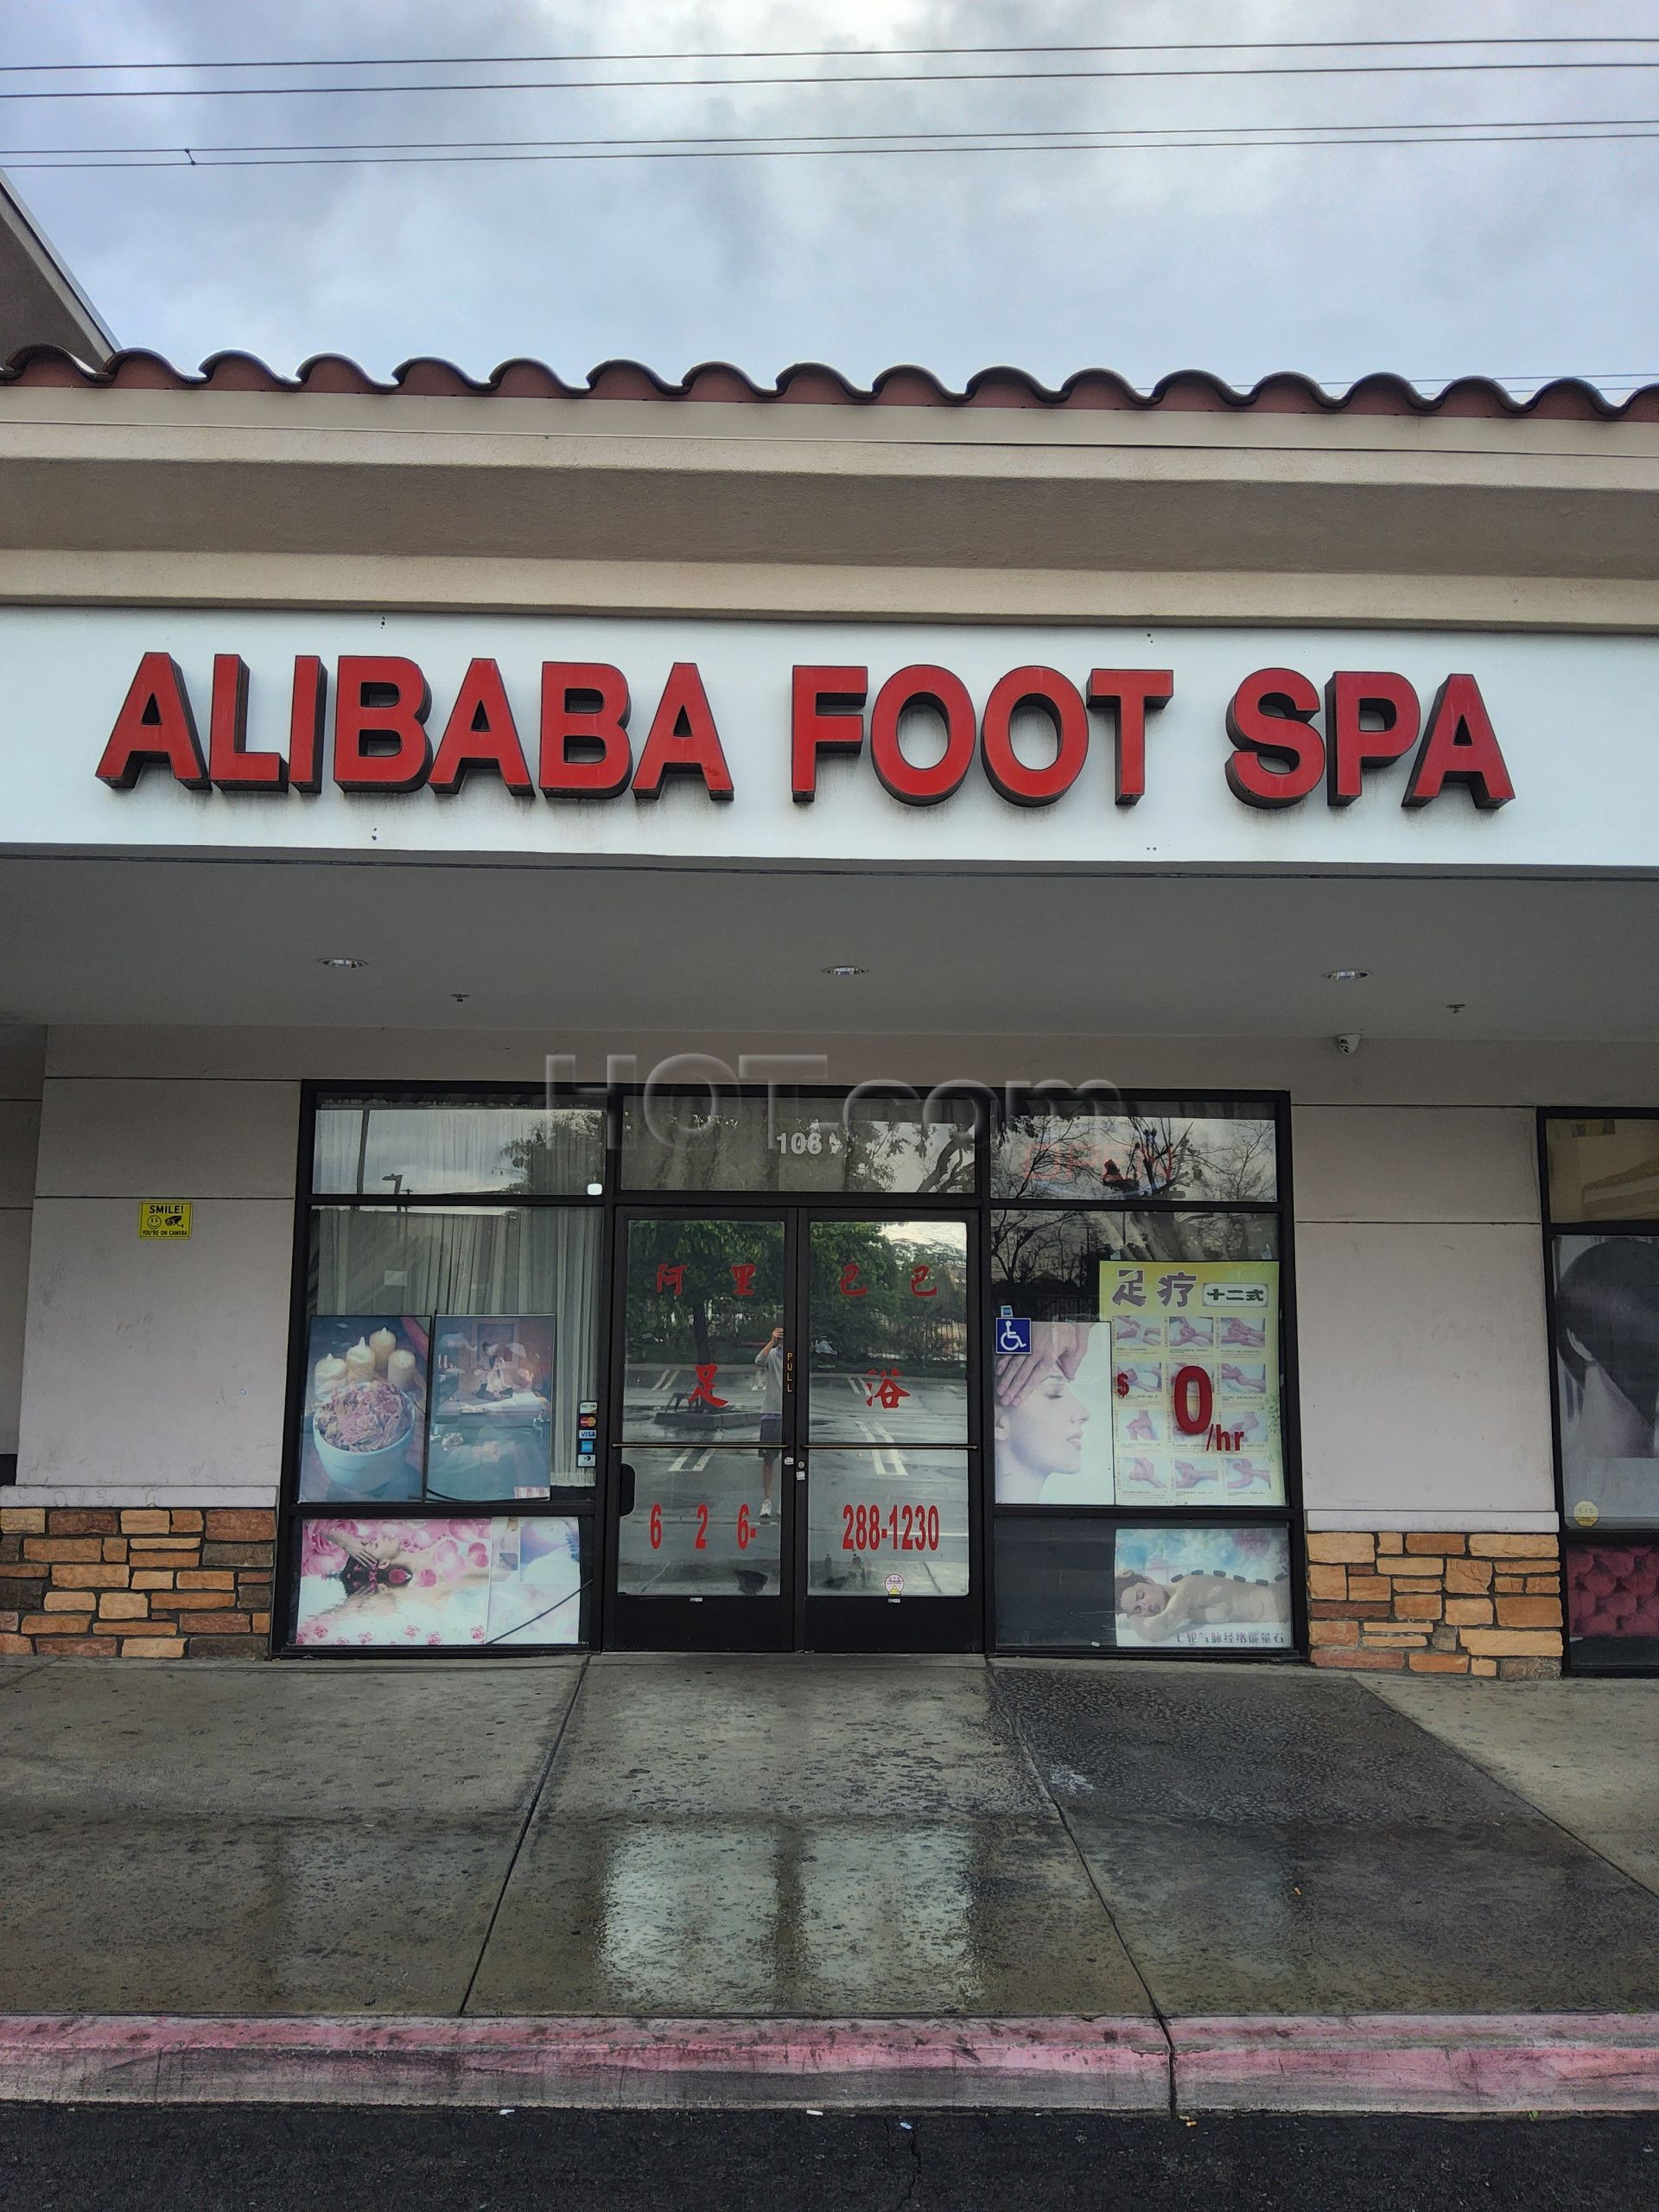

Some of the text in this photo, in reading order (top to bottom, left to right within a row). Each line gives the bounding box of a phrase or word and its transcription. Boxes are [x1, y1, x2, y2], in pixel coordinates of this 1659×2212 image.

[95, 652, 1516, 809] ALIBABA FOOT SPA
[776, 1132, 823, 1155] 106
[149, 1205, 184, 1214] SMILE!
[1206, 1287, 1265, 1303] 十二式
[842, 1503, 939, 1550] 288-1230
